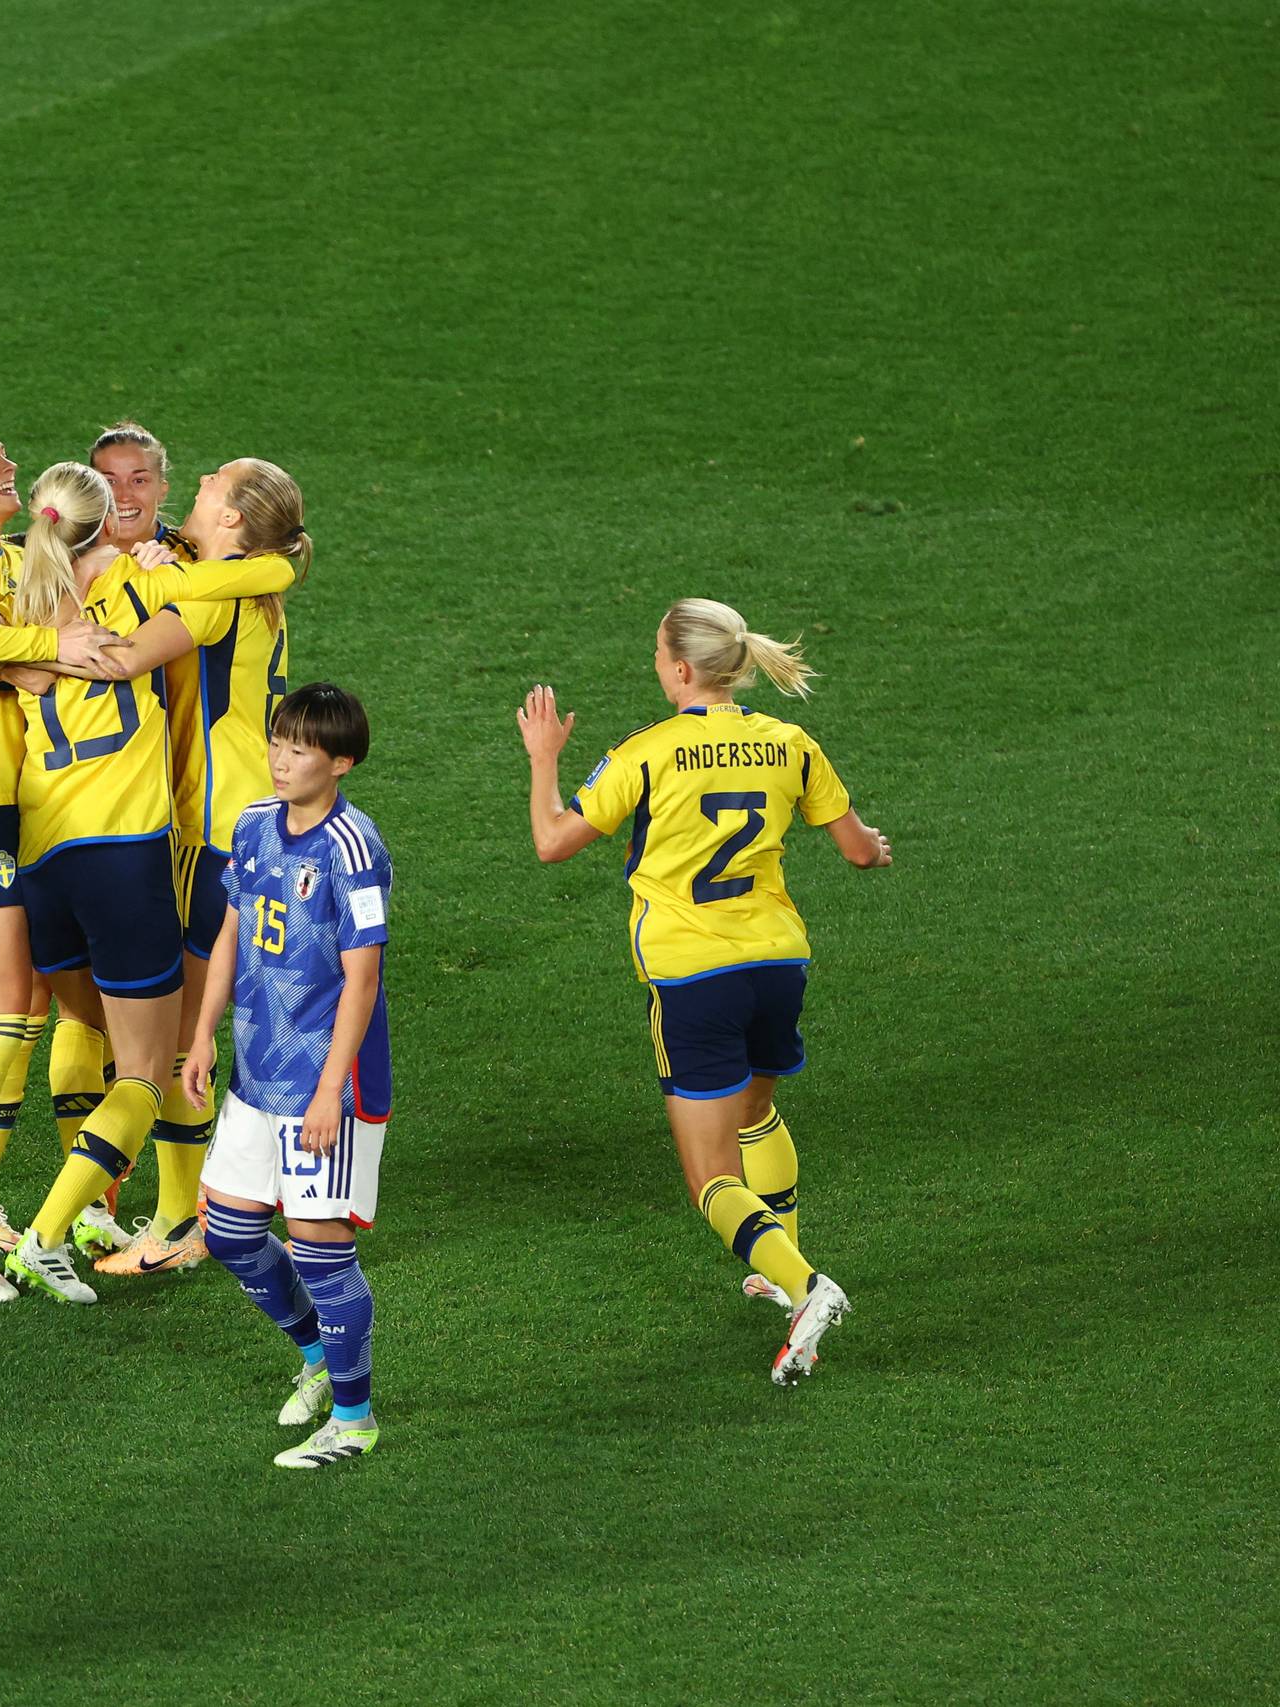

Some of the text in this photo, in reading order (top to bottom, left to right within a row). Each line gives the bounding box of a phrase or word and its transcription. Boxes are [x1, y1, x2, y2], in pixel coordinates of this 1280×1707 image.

[675, 742, 788, 772] ANDERSSON
[692, 791, 767, 905] 2
[252, 894, 287, 955] 15
[278, 1123, 322, 1176] 15
